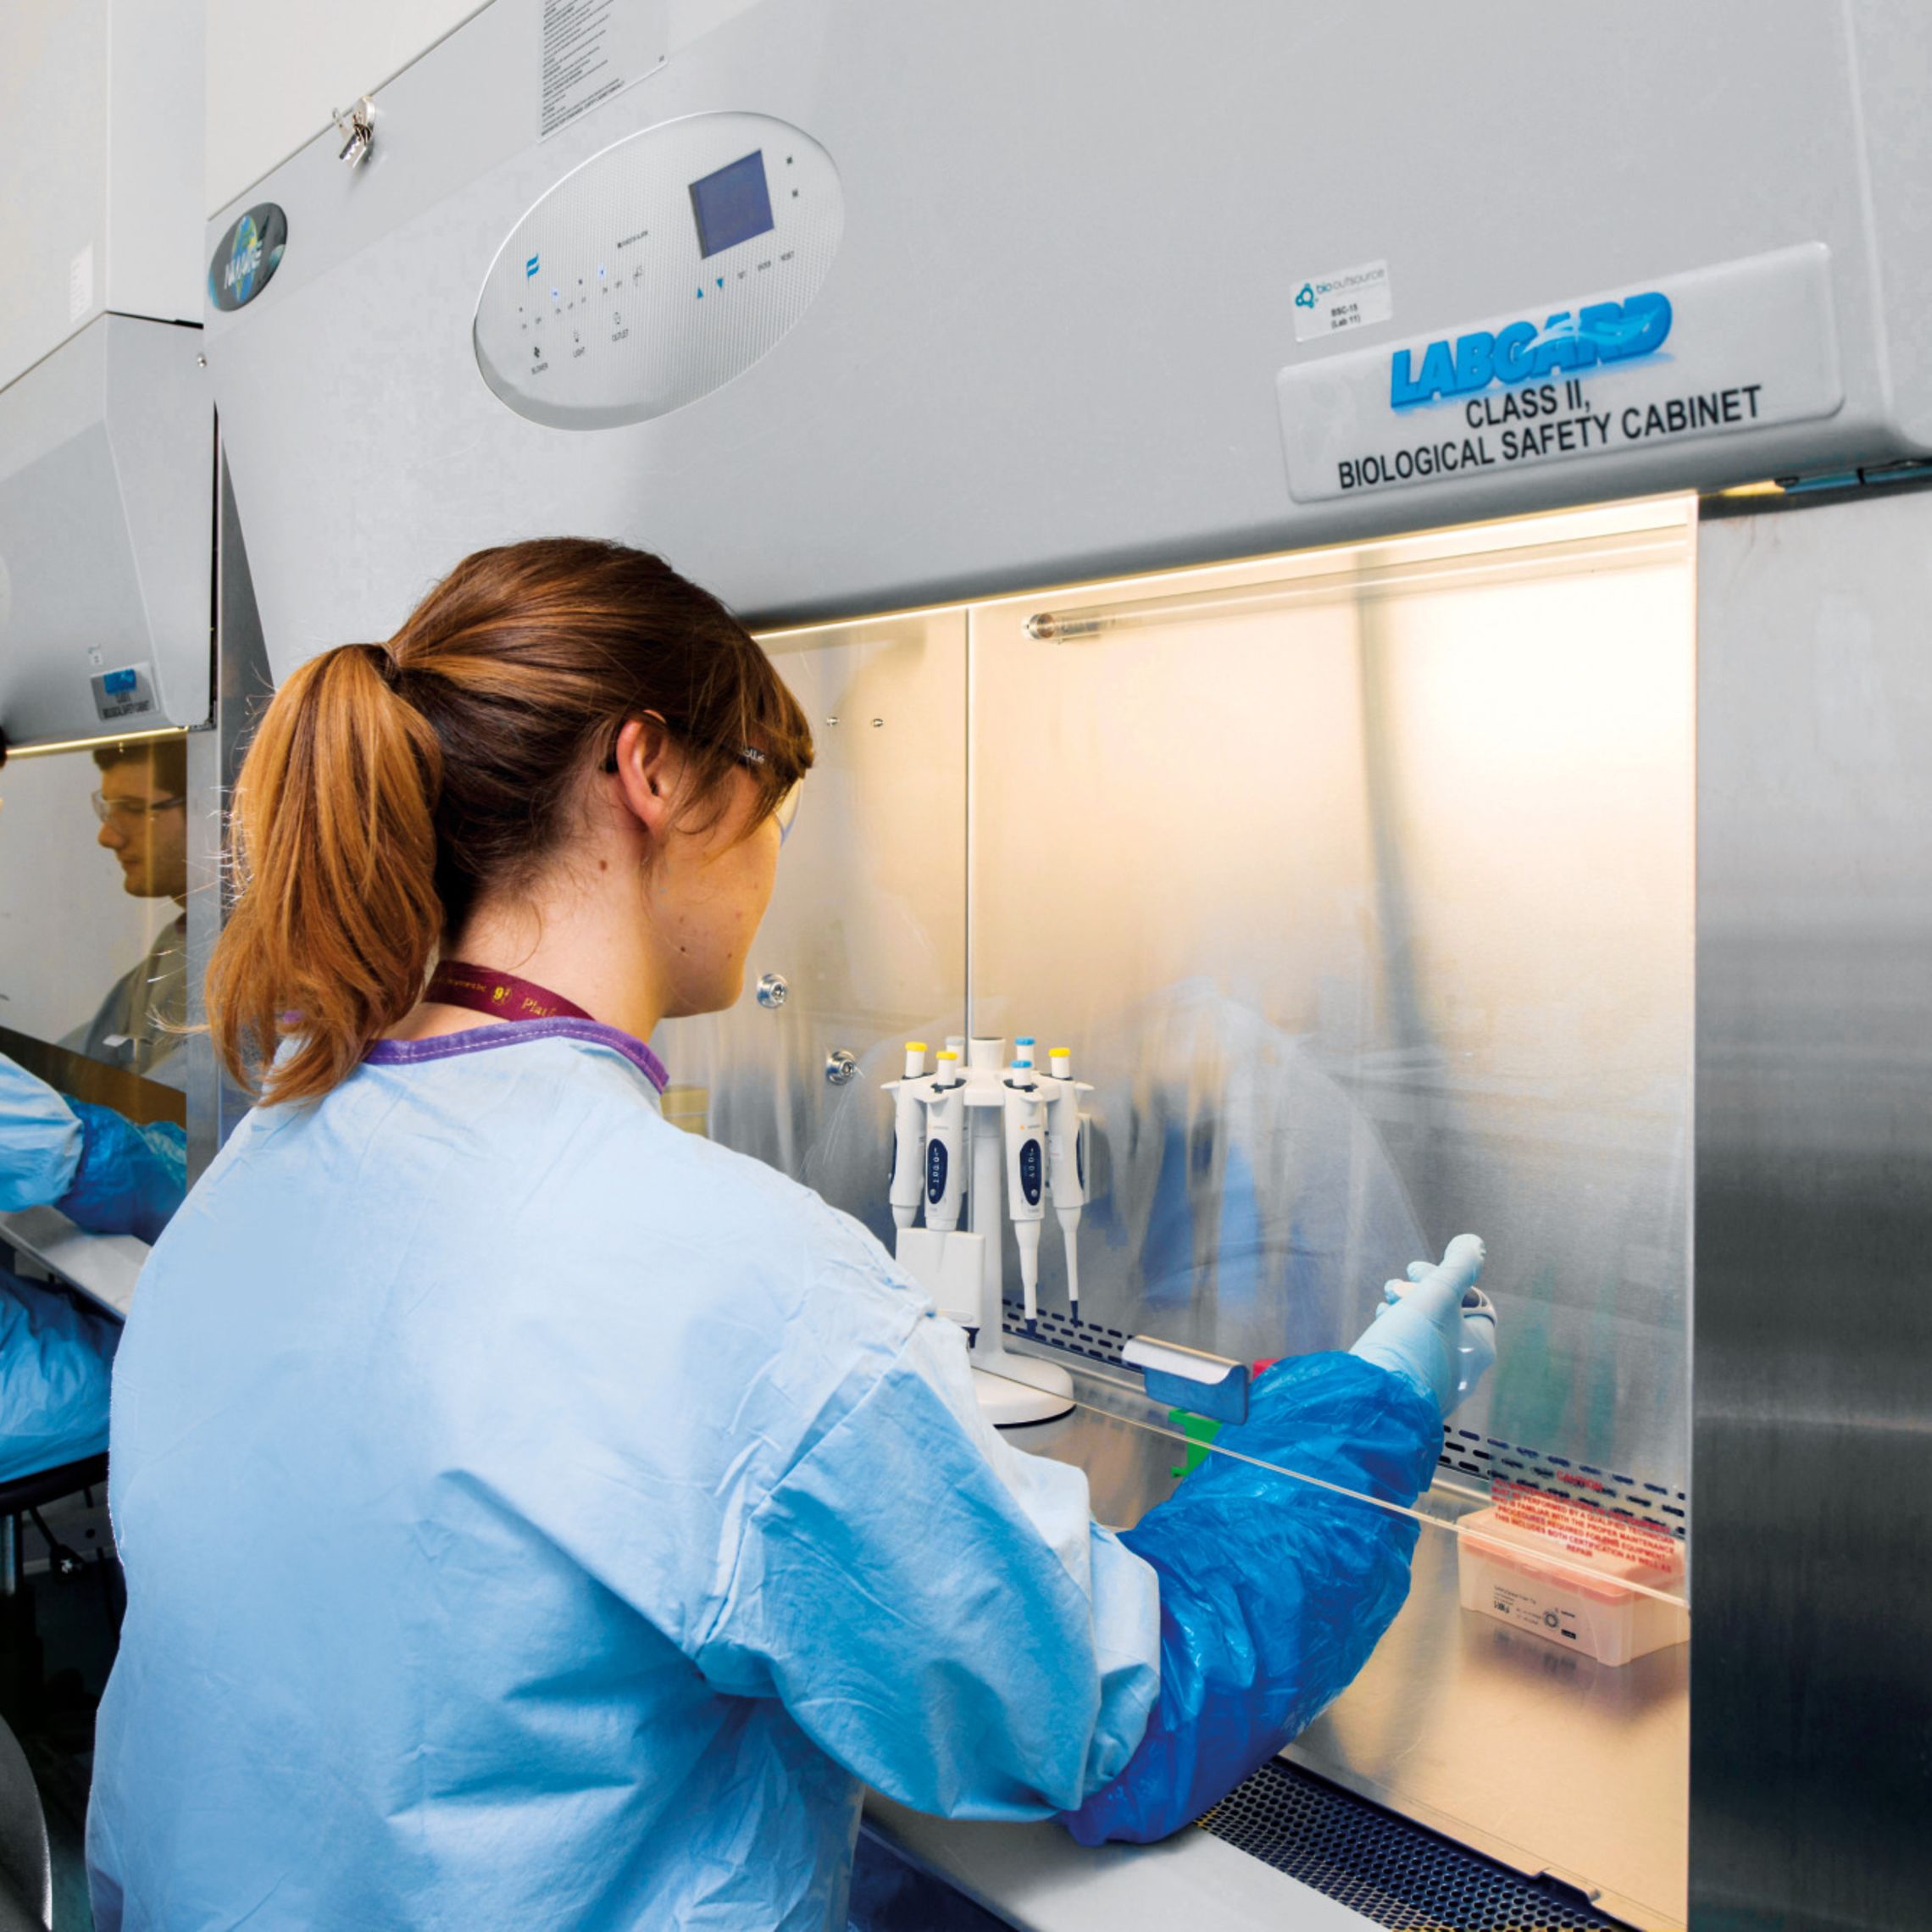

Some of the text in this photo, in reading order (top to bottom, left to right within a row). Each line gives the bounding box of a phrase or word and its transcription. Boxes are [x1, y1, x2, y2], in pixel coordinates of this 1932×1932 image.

[1391, 291, 1672, 409] LABGARD
[1338, 386, 1762, 490] BIOLOGICAL SAFETY CABINET
[1465, 379, 1591, 429] CLASS II,
